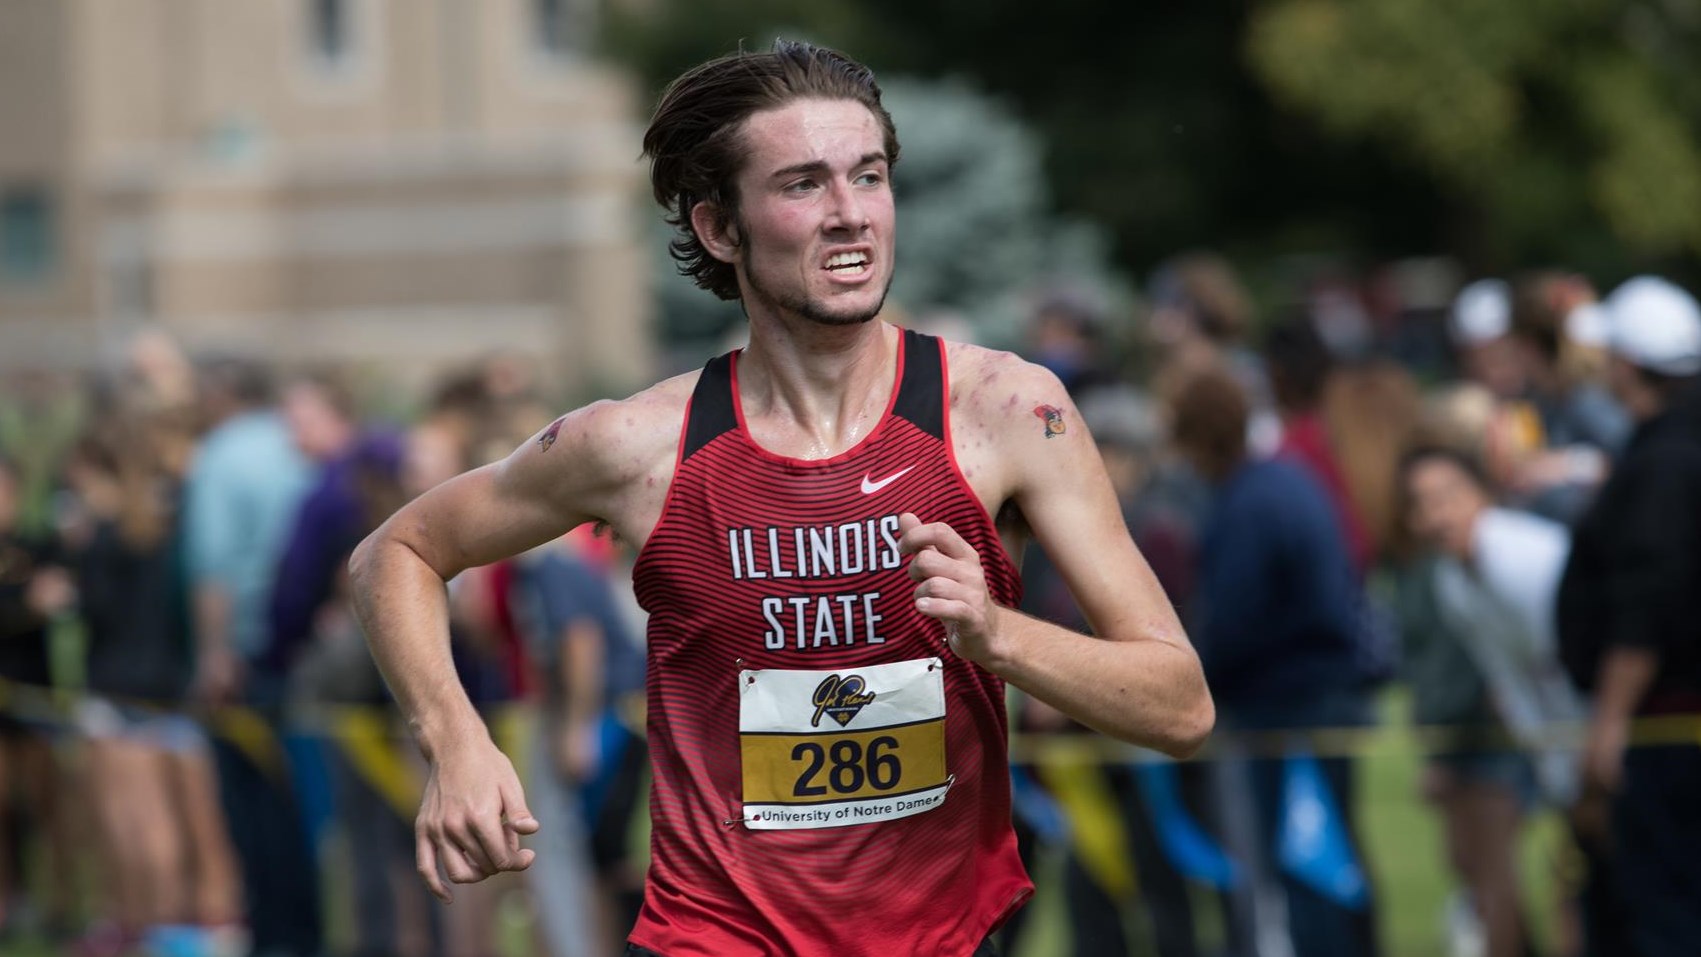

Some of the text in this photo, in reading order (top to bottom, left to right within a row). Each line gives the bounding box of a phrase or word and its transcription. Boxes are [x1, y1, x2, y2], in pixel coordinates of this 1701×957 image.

[728, 513, 901, 579] ILLINOIS
[761, 591, 886, 650] STATE
[791, 735, 902, 797] 286
[762, 796, 932, 823] University of Notre Dame
